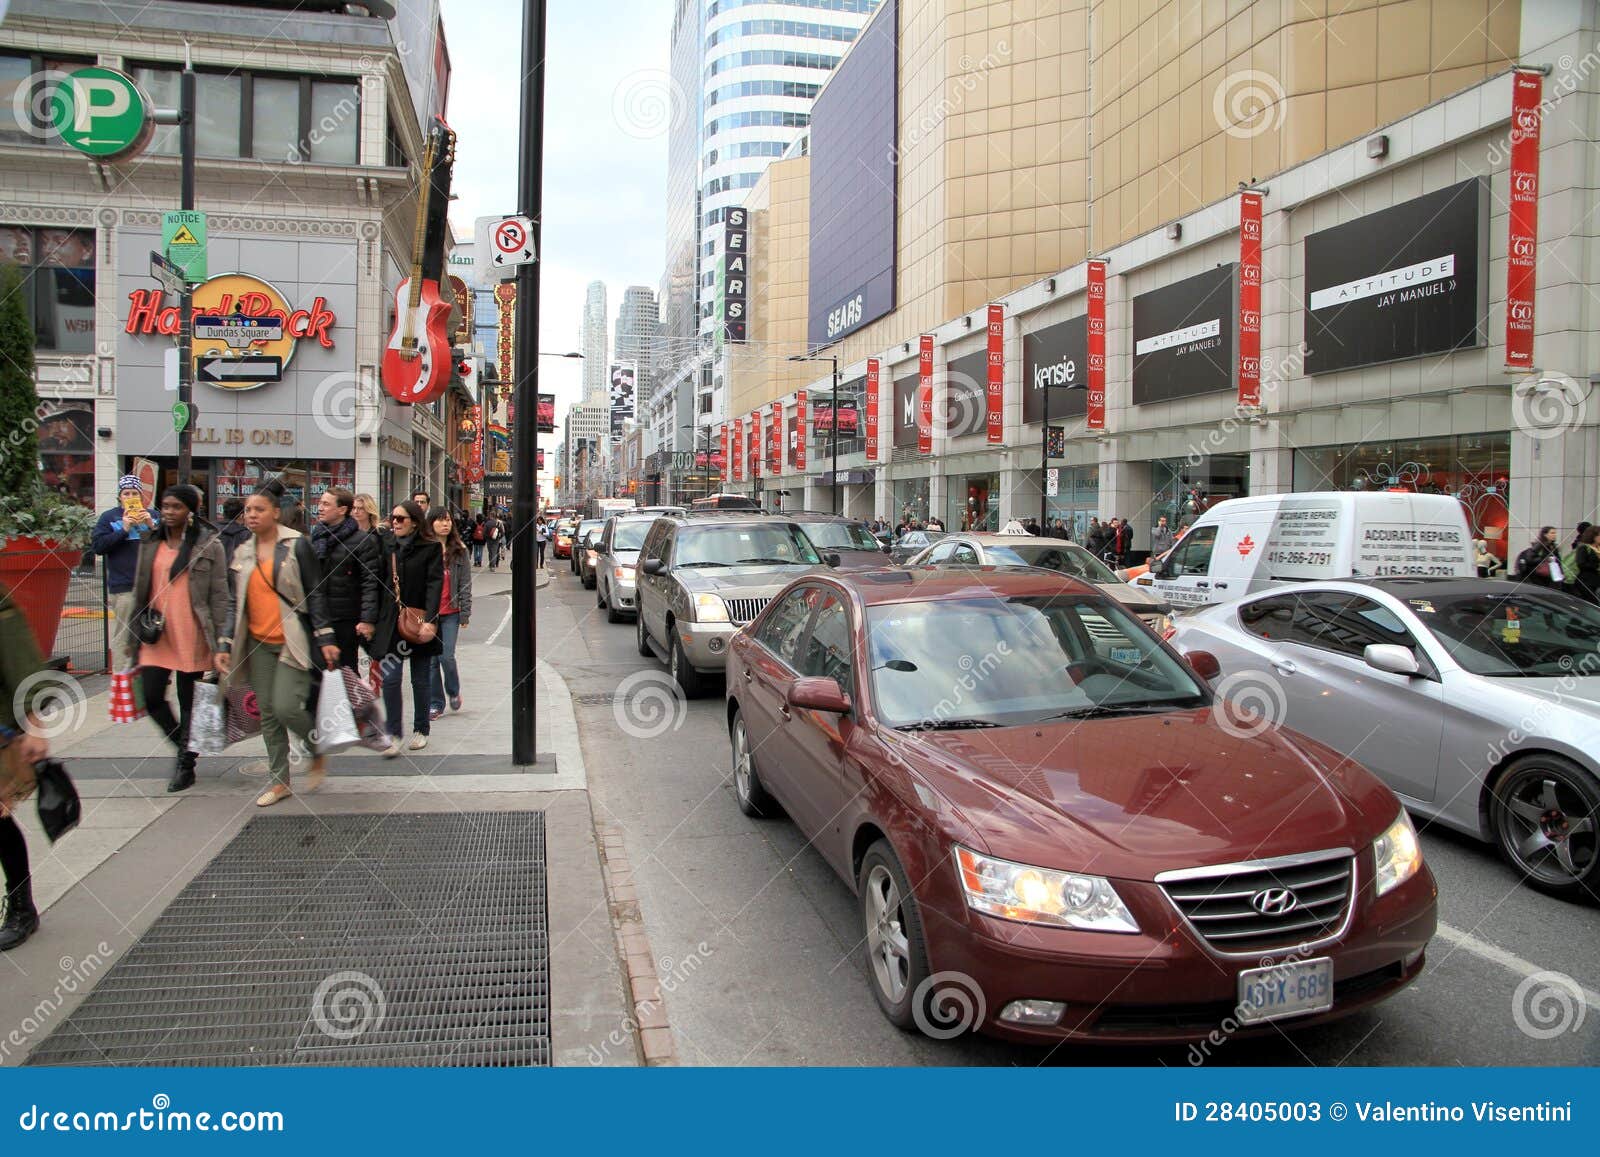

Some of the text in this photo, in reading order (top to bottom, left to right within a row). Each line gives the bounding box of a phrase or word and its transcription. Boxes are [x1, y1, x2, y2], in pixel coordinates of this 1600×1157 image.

[74, 78, 130, 132] P
[1516, 176, 1536, 192] 60
[168, 214, 200, 223] NOTICE
[1513, 239, 1534, 256] 60
[729, 210, 744, 318] SEARS
[1339, 262, 1448, 298] ATTITUDE
[1377, 283, 1446, 308] JAY MANUEL
[827, 294, 862, 337] SEARS
[1511, 302, 1532, 319] 60
[207, 326, 270, 340] Dundas Square
[1153, 323, 1217, 347] ATTITUDE
[1176, 340, 1215, 356] JAY MANUEL
[1034, 355, 1075, 389] kensie
[192, 428, 294, 446] LL IS ONE
[1279, 511, 1337, 520] ACCURATE REPAIRS
[1365, 529, 1460, 543] ACCURATE REPAIRS
[1268, 551, 1331, 565] 416-266-2791
